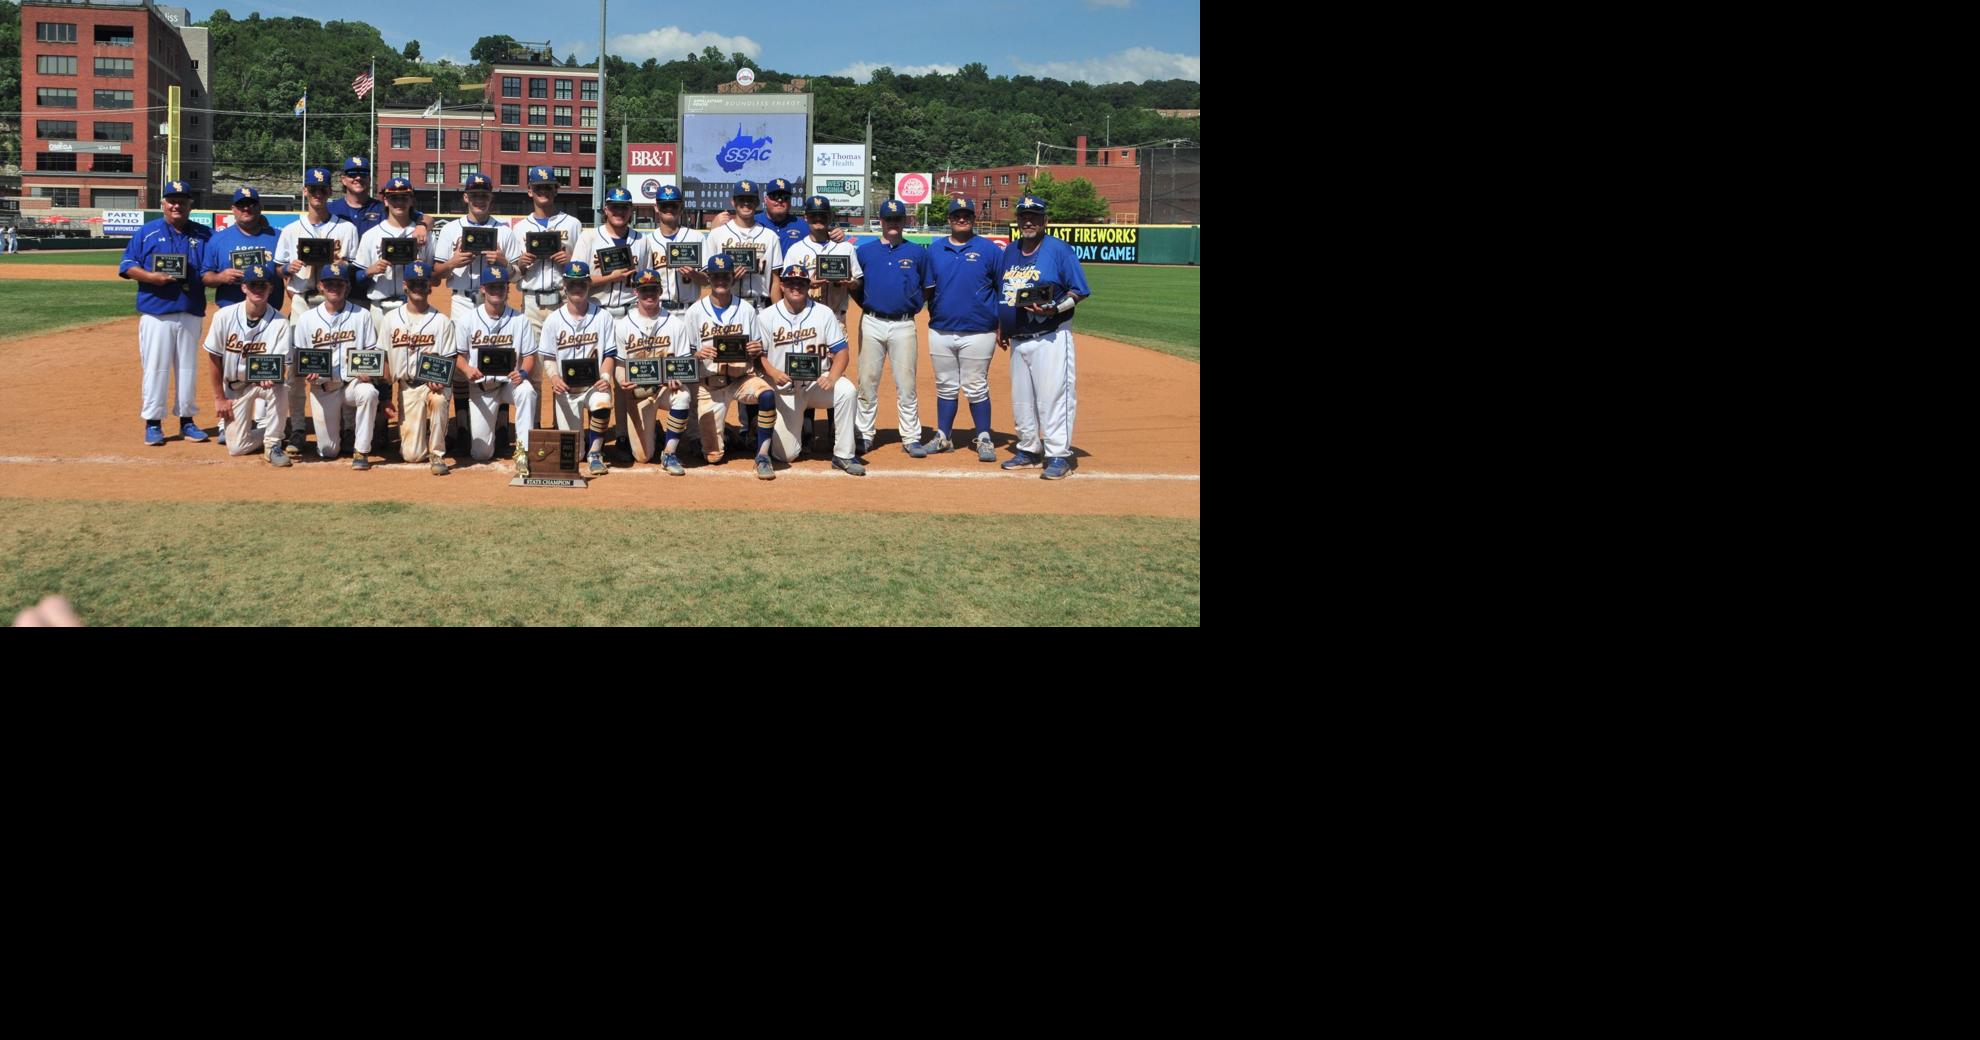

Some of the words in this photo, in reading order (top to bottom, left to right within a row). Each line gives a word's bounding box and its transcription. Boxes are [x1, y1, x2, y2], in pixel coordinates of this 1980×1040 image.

[631, 150, 673, 166] BB&T
[726, 148, 772, 162] SSAC
[845, 181, 859, 190] 811
[1074, 228, 1136, 243] FIREWORKS
[1101, 246, 1135, 260] GAME!
[312, 328, 356, 348] Logan
[392, 328, 435, 350] Logan
[472, 330, 513, 348] Logan
[556, 330, 599, 350] Logan
[700, 322, 743, 342] Logan
[773, 326, 817, 346] Logan
[226, 334, 267, 357] Logan
[625, 334, 670, 354] Logan
